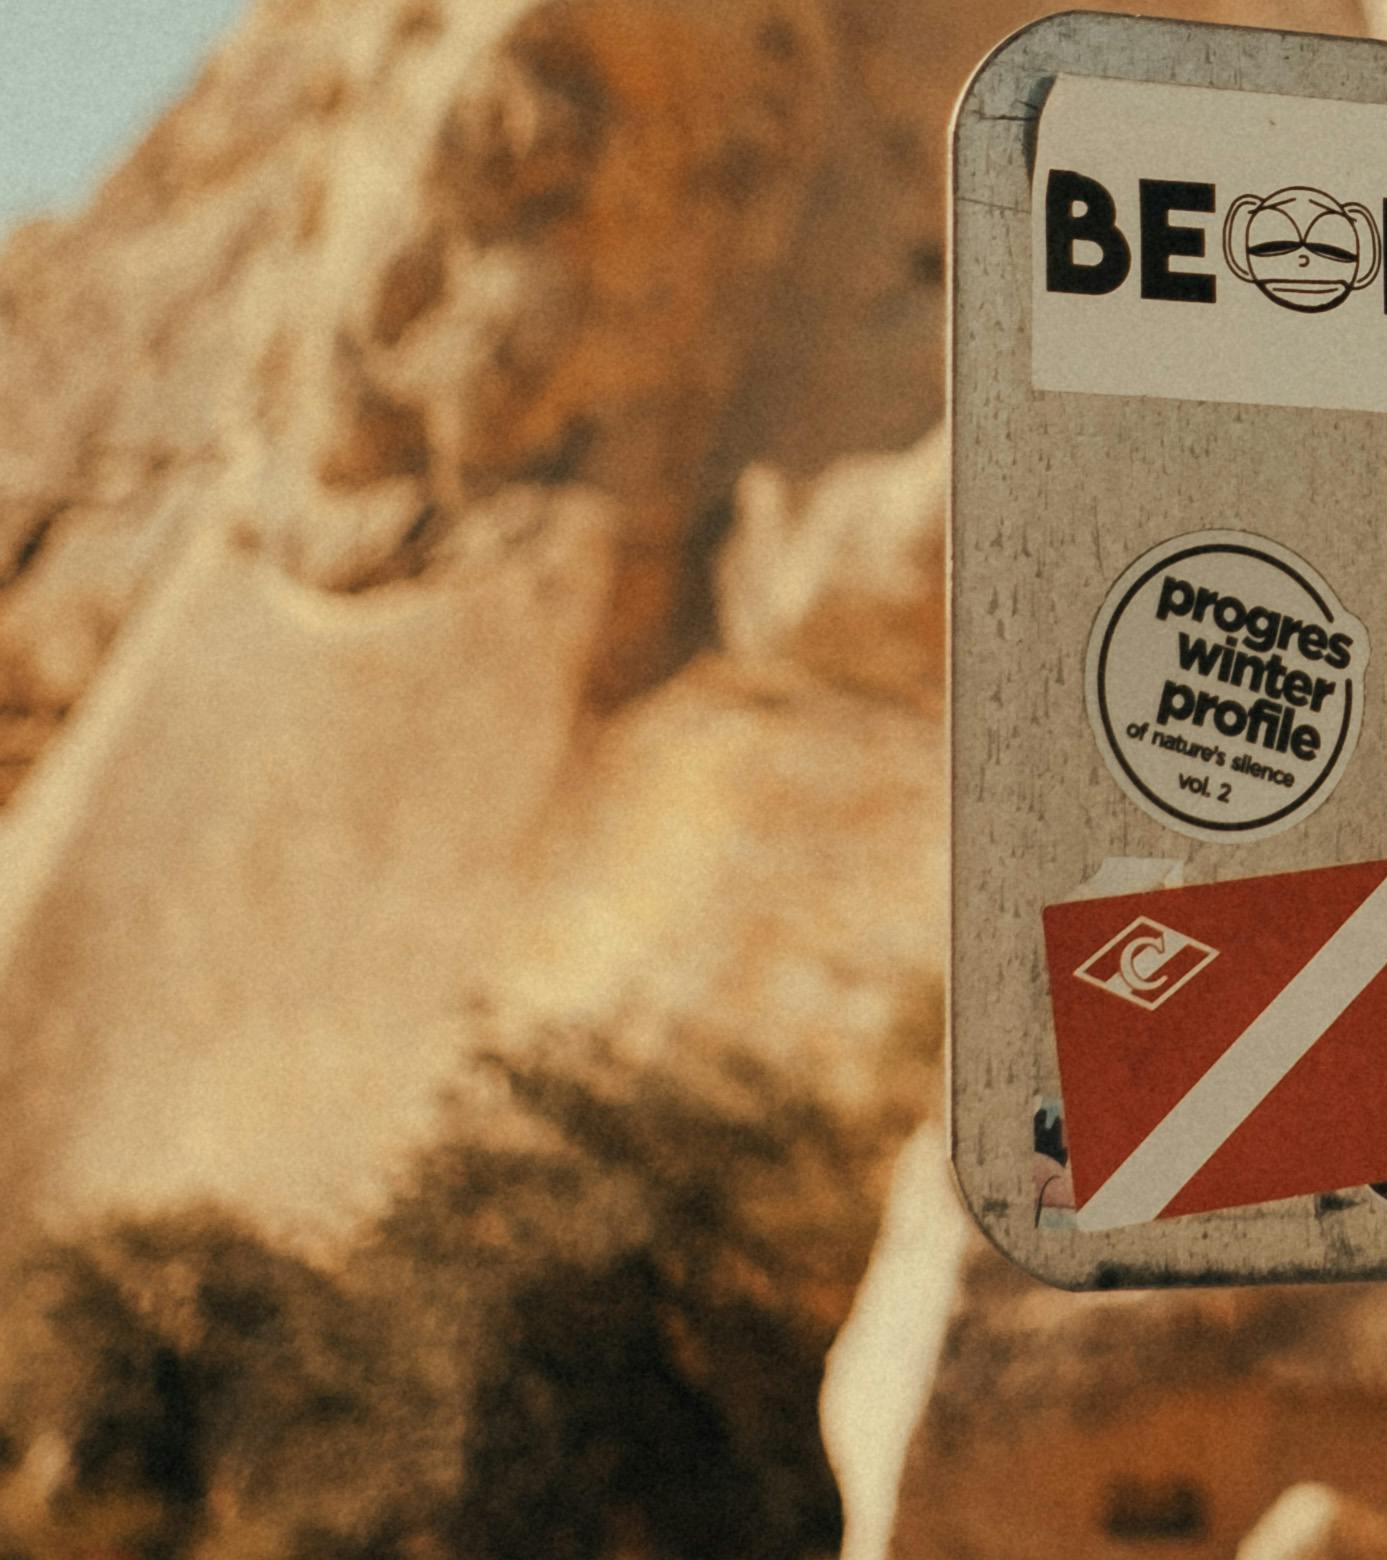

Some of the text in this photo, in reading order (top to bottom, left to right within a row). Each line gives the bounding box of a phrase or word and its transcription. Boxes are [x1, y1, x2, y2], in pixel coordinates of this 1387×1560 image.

[1045, 168, 1217, 304] BE
[1155, 575, 1353, 670] progres
[1179, 631, 1336, 713] winter
[1126, 721, 1296, 788] of nature's silence
[1156, 680, 1321, 761] profile
[1178, 773, 1232, 804] vol. 2
